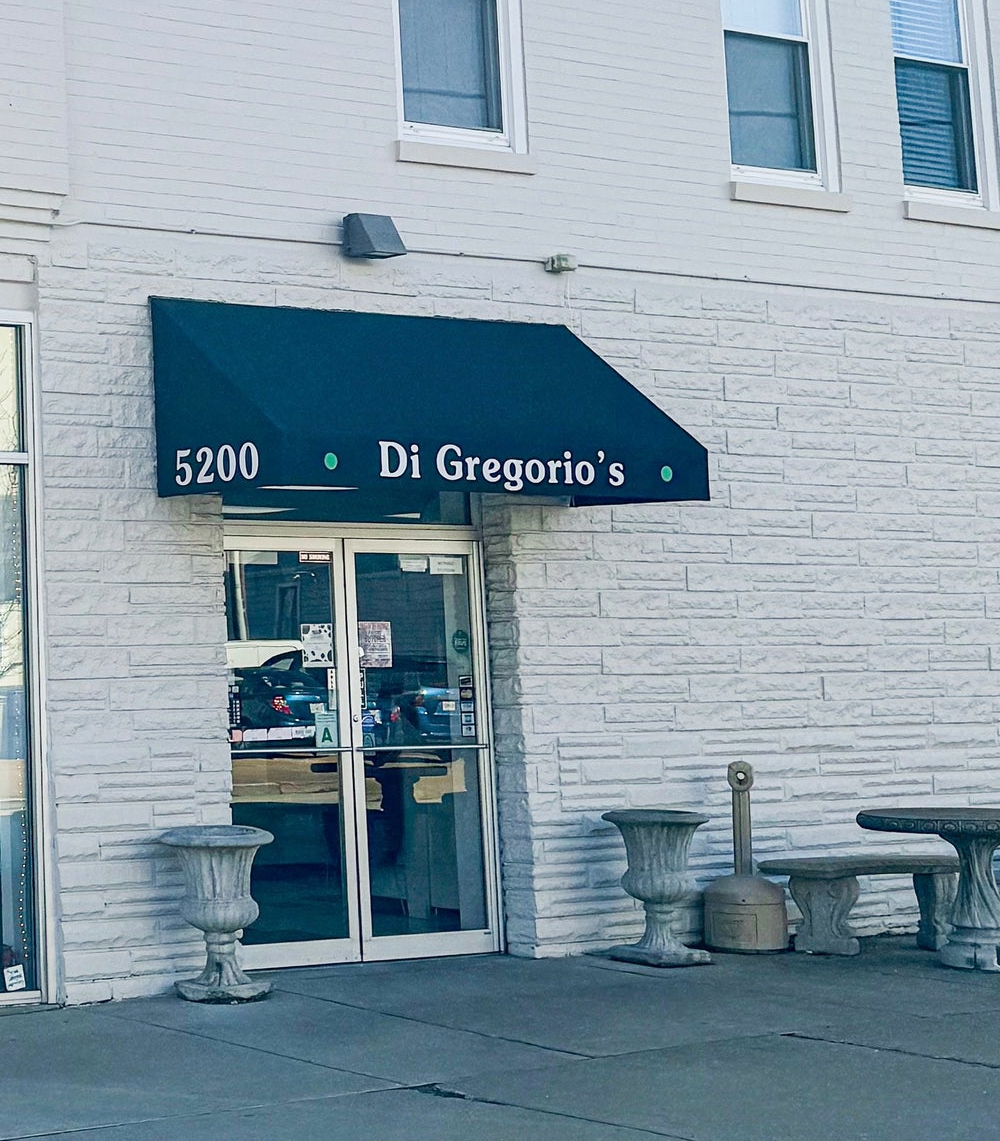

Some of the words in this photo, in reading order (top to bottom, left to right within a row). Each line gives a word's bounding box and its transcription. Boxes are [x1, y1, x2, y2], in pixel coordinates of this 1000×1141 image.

[174, 441, 260, 487] 5200
[378, 440, 422, 479] Di
[435, 443, 626, 492] Gregorio's
[321, 726, 334, 743] A
